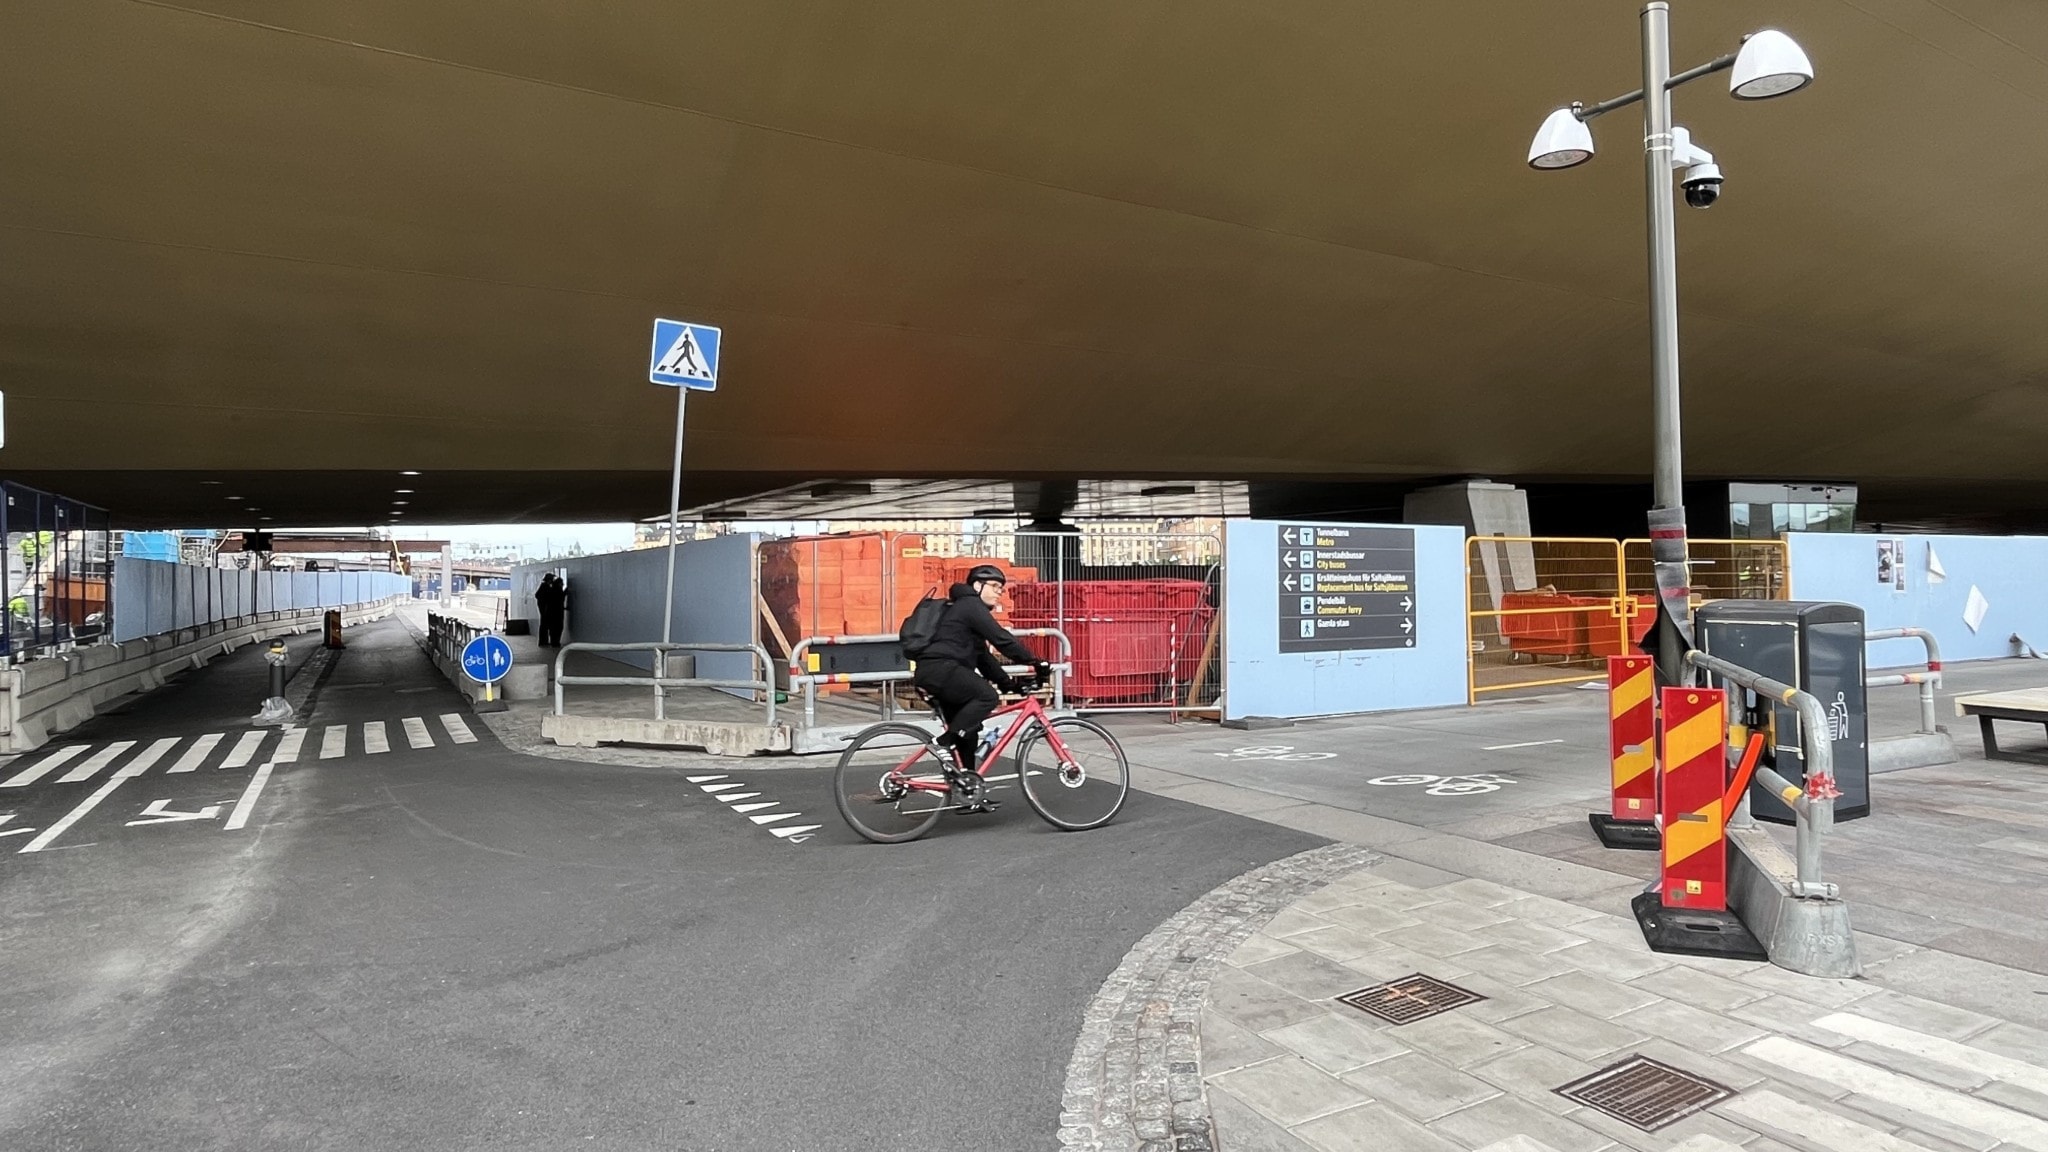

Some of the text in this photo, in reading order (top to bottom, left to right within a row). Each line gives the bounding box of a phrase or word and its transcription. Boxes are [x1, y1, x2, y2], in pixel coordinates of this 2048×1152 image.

[1317, 528, 1349, 537] Tunnelbana
[1317, 537, 1335, 546] Metro
[1317, 551, 1365, 560] Innerstadsbussar
[1317, 560, 1346, 570] City buses
[1362, 573, 1370, 582] för
[1317, 583, 1354, 593] Replacement
[1354, 583, 1364, 591] bus
[1364, 583, 1373, 591] for
[1317, 596, 1346, 605] Pendelbåt
[1317, 605, 1347, 615] Commuter
[1317, 619, 1350, 628] Gamla stan
